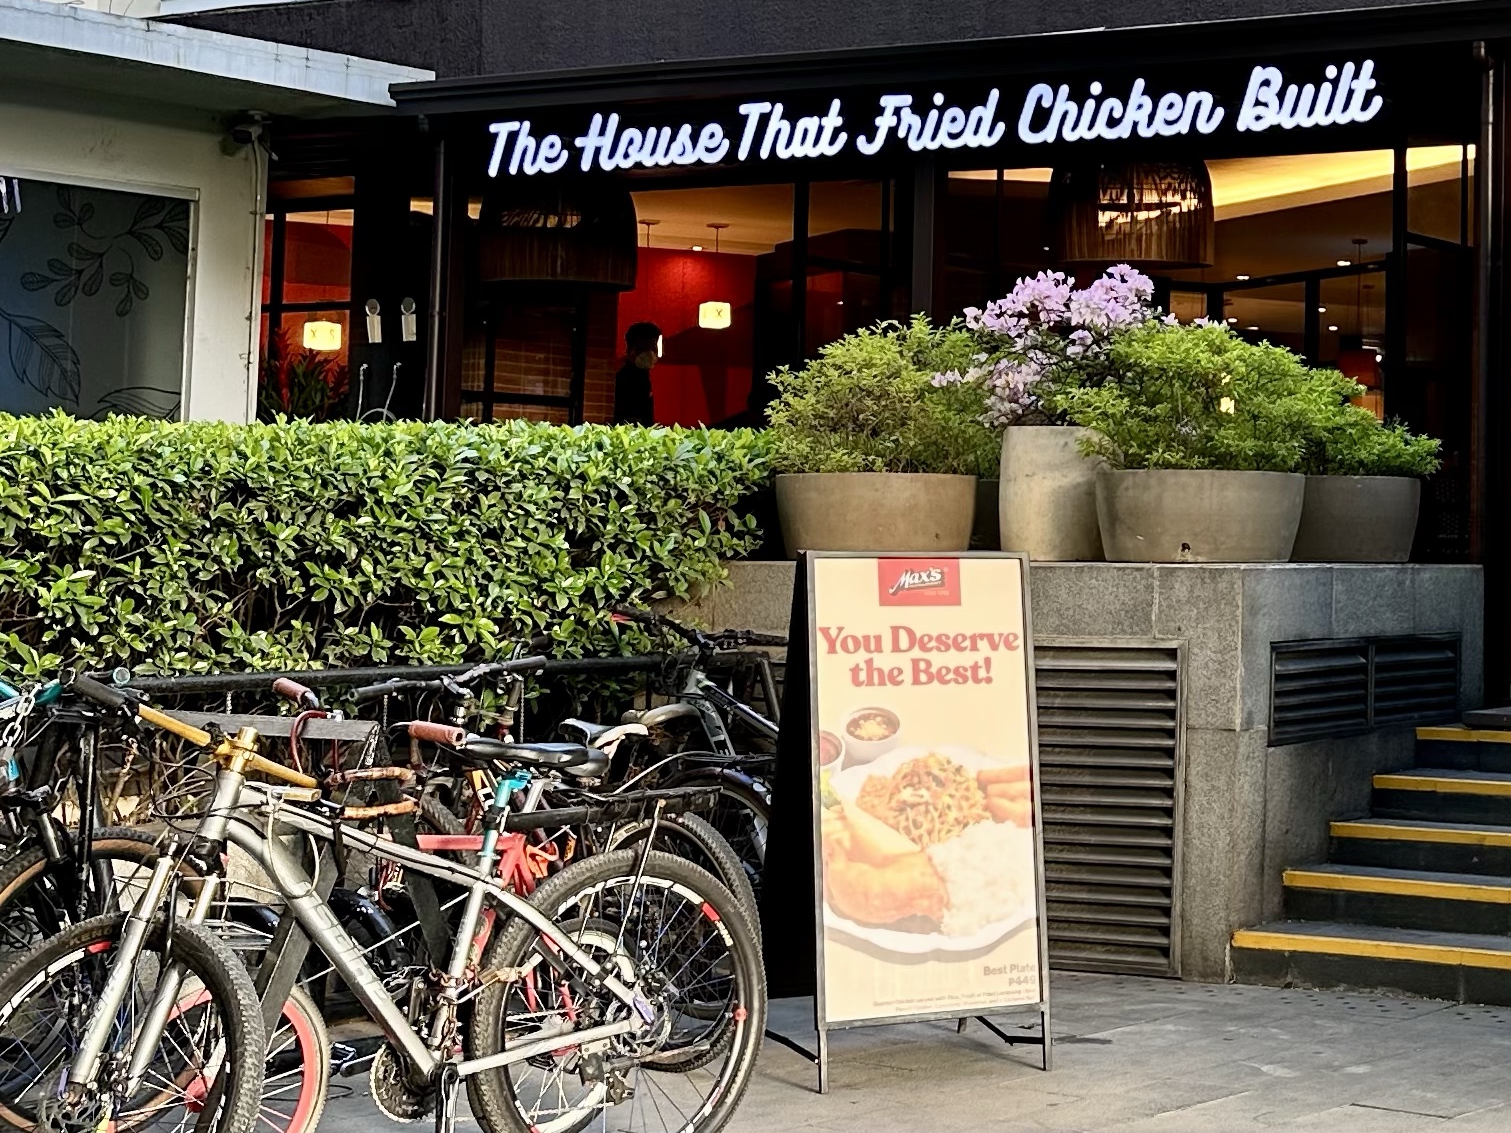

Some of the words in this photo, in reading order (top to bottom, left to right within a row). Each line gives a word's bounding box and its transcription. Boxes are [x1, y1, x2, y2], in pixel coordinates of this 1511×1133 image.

[486, 119, 569, 178] The
[573, 112, 730, 173] House
[736, 98, 848, 162] That
[855, 87, 1006, 157] Fried
[1017, 77, 1225, 145] Chicken
[1236, 58, 1385, 133] Built
[888, 567, 942, 595] Max's
[818, 626, 884, 655] You
[889, 625, 1020, 654] Deserve
[849, 656, 905, 687] the
[910, 656, 994, 686] Best!
[983, 965, 1008, 977] Best
[1009, 963, 1036, 974] Plate
